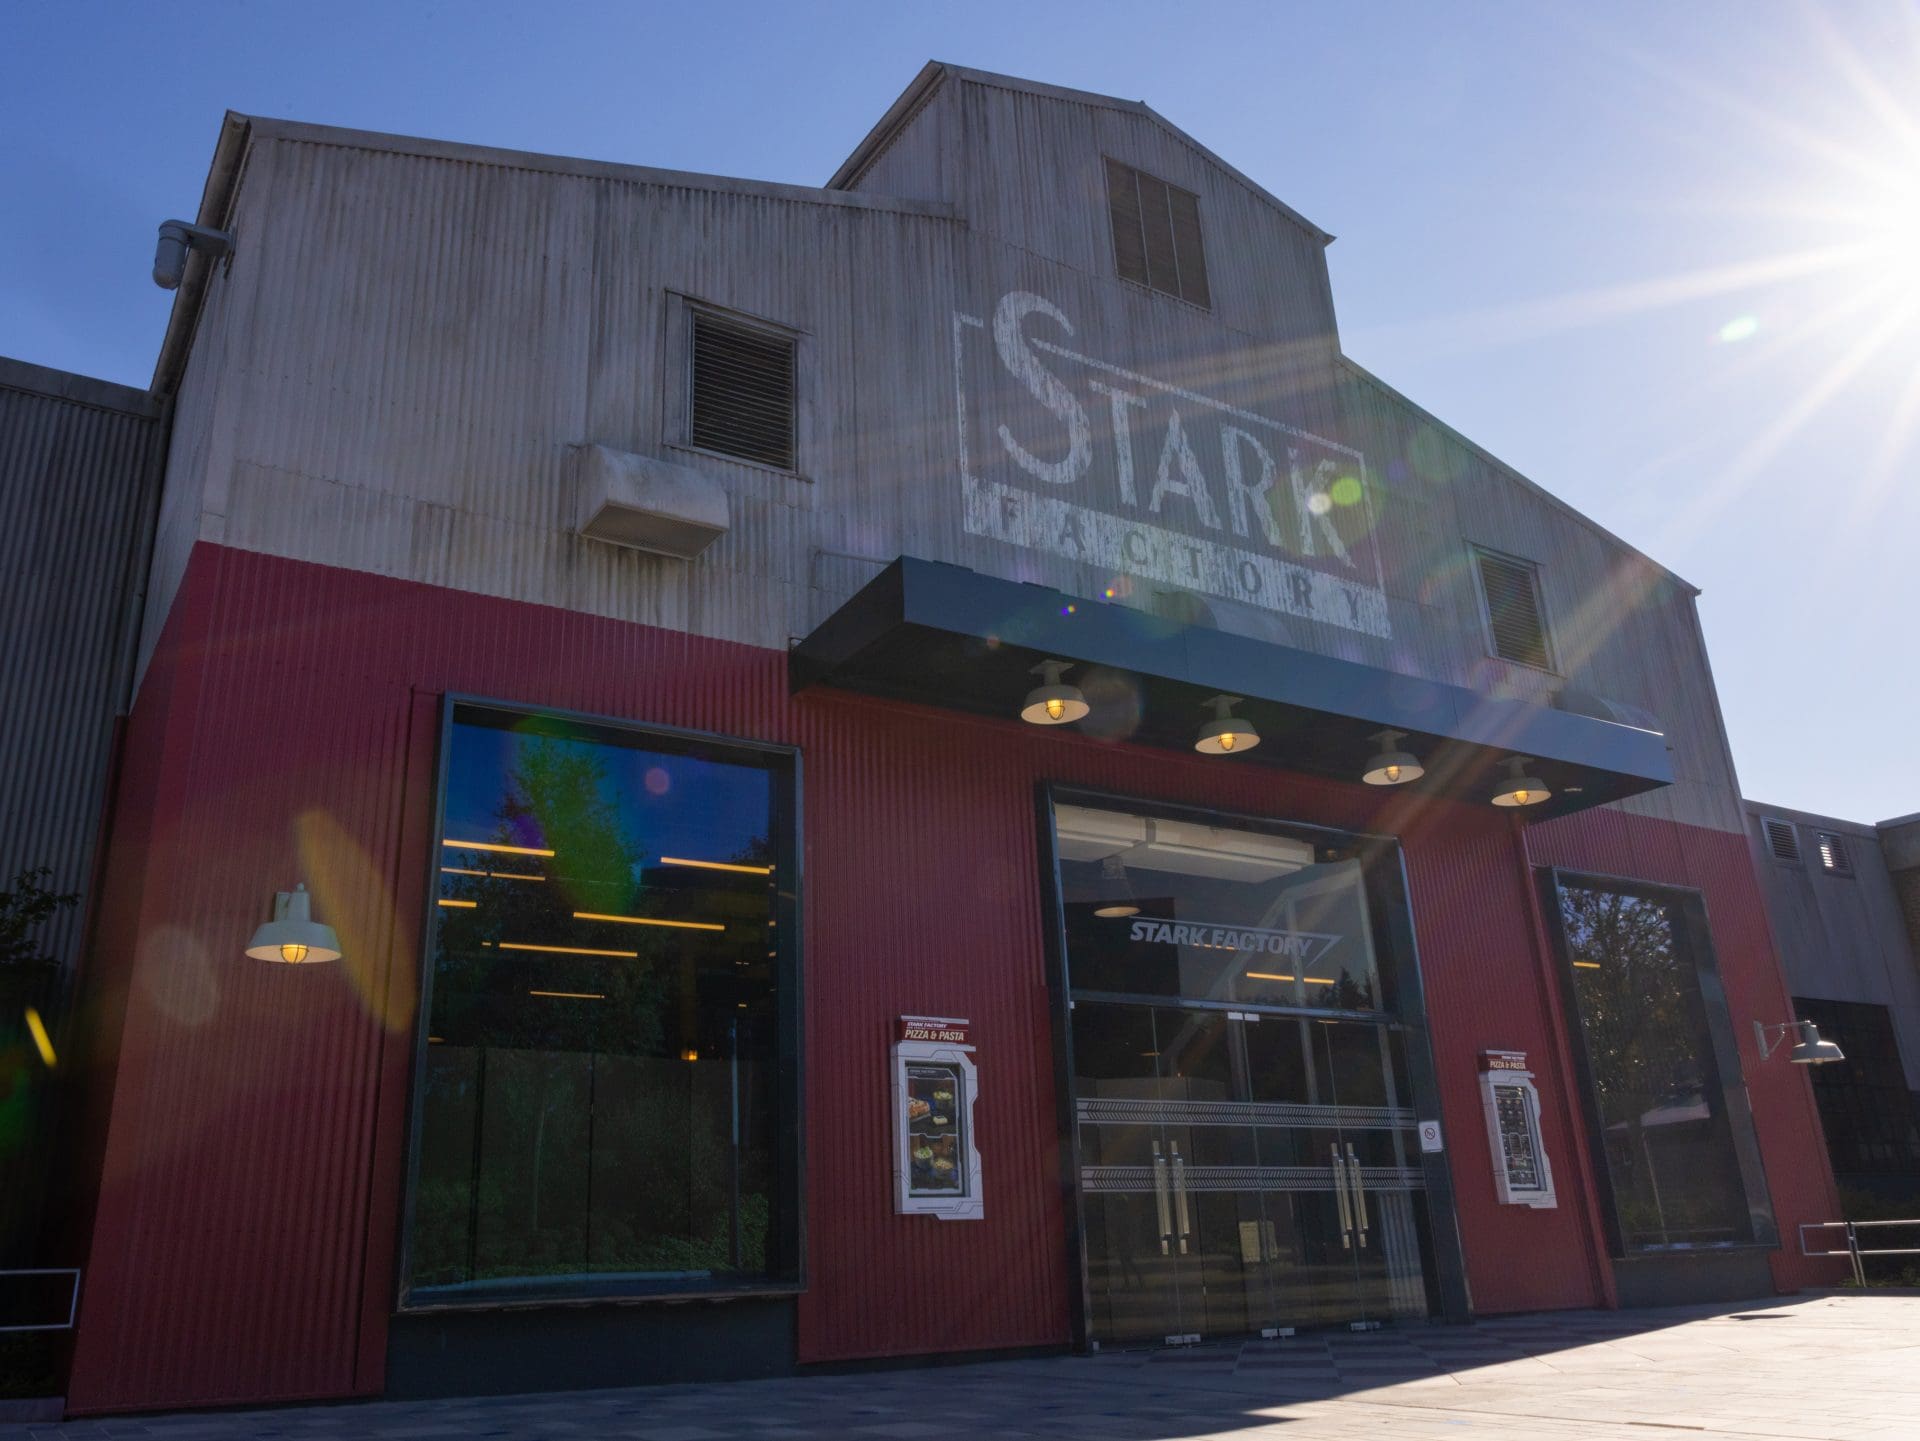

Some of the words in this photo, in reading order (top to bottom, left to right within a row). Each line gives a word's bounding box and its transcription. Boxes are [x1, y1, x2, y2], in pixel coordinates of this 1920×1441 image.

[993, 291, 1357, 569] STARK
[1001, 497, 1361, 625] FACTORY
[1129, 921, 1207, 945] STARK
[1211, 931, 1312, 957] FACTORY
[905, 1030, 929, 1039] PIZZA
[930, 1031, 937, 1040] &
[939, 1031, 964, 1040] PASTA
[1490, 1061, 1504, 1069] PIZZA
[1511, 1062, 1526, 1070] PASTA
